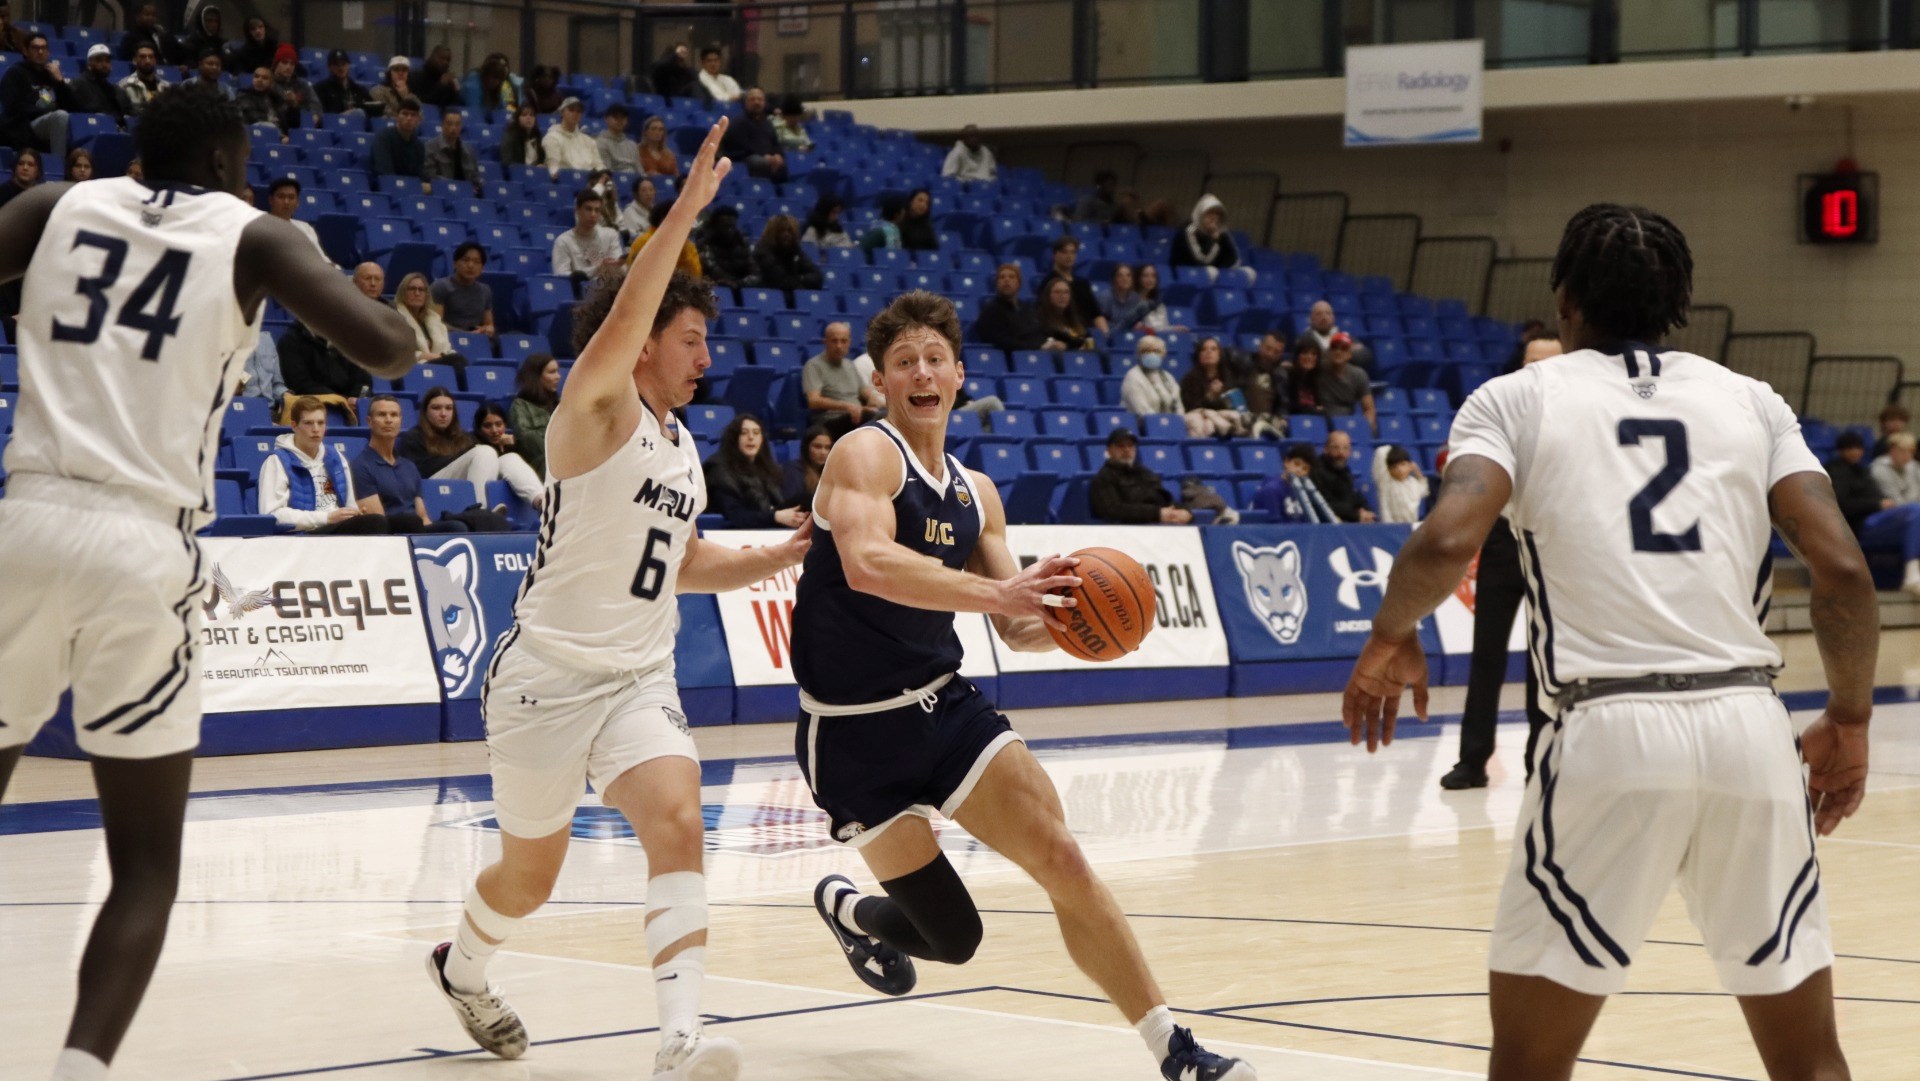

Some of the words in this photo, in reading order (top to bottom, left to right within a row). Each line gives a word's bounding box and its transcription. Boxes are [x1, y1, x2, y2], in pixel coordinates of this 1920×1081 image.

[51, 228, 194, 363] 34
[633, 477, 695, 522] MRU
[1616, 417, 1703, 553] 2
[630, 526, 672, 602] 6
[271, 578, 412, 631] EAGLE
[1088, 570, 1133, 632] EVOLUTION
[247, 627, 259, 645] &
[265, 624, 344, 644] CASINO
[215, 668, 274, 680] BEAUTIFUL
[330, 664, 369, 675] NATION
